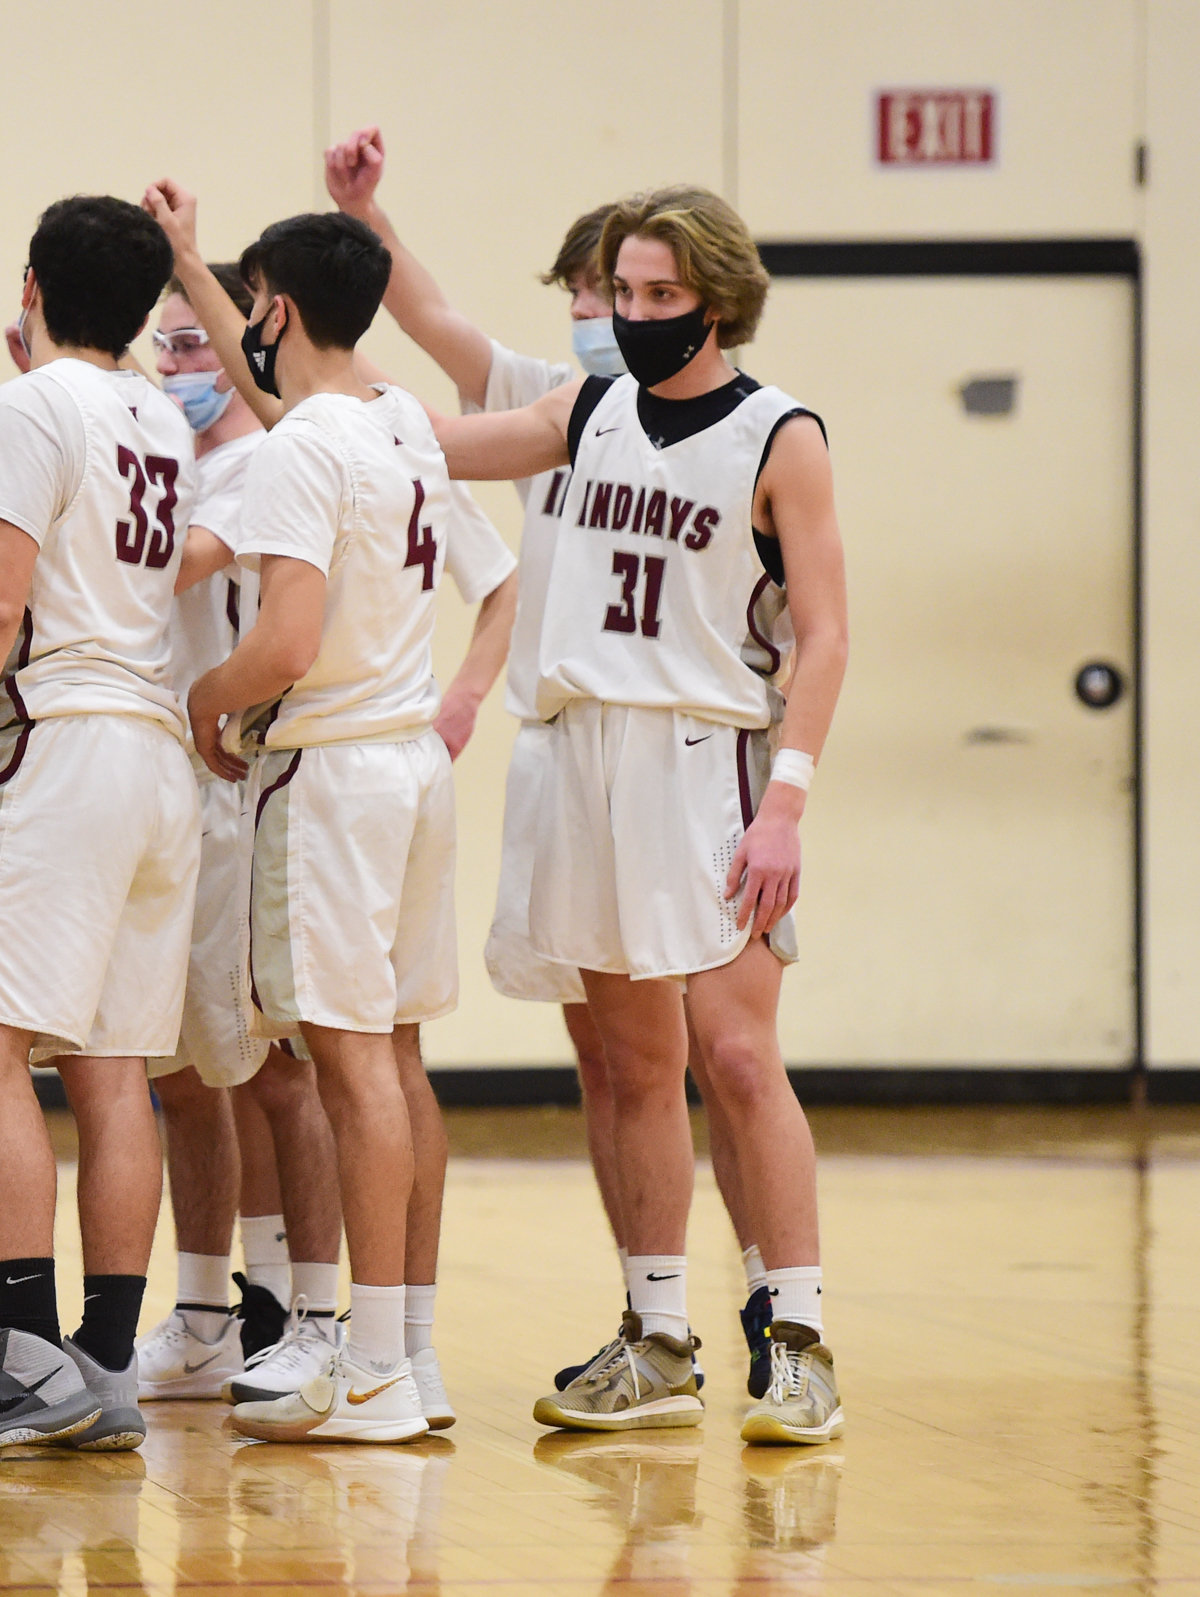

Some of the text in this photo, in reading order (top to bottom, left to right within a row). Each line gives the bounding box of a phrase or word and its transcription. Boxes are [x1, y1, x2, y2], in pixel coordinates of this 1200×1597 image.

[887, 95, 984, 161] EXIT
[116, 441, 180, 571] 33
[402, 475, 437, 593] 4
[601, 548, 668, 640] 31
